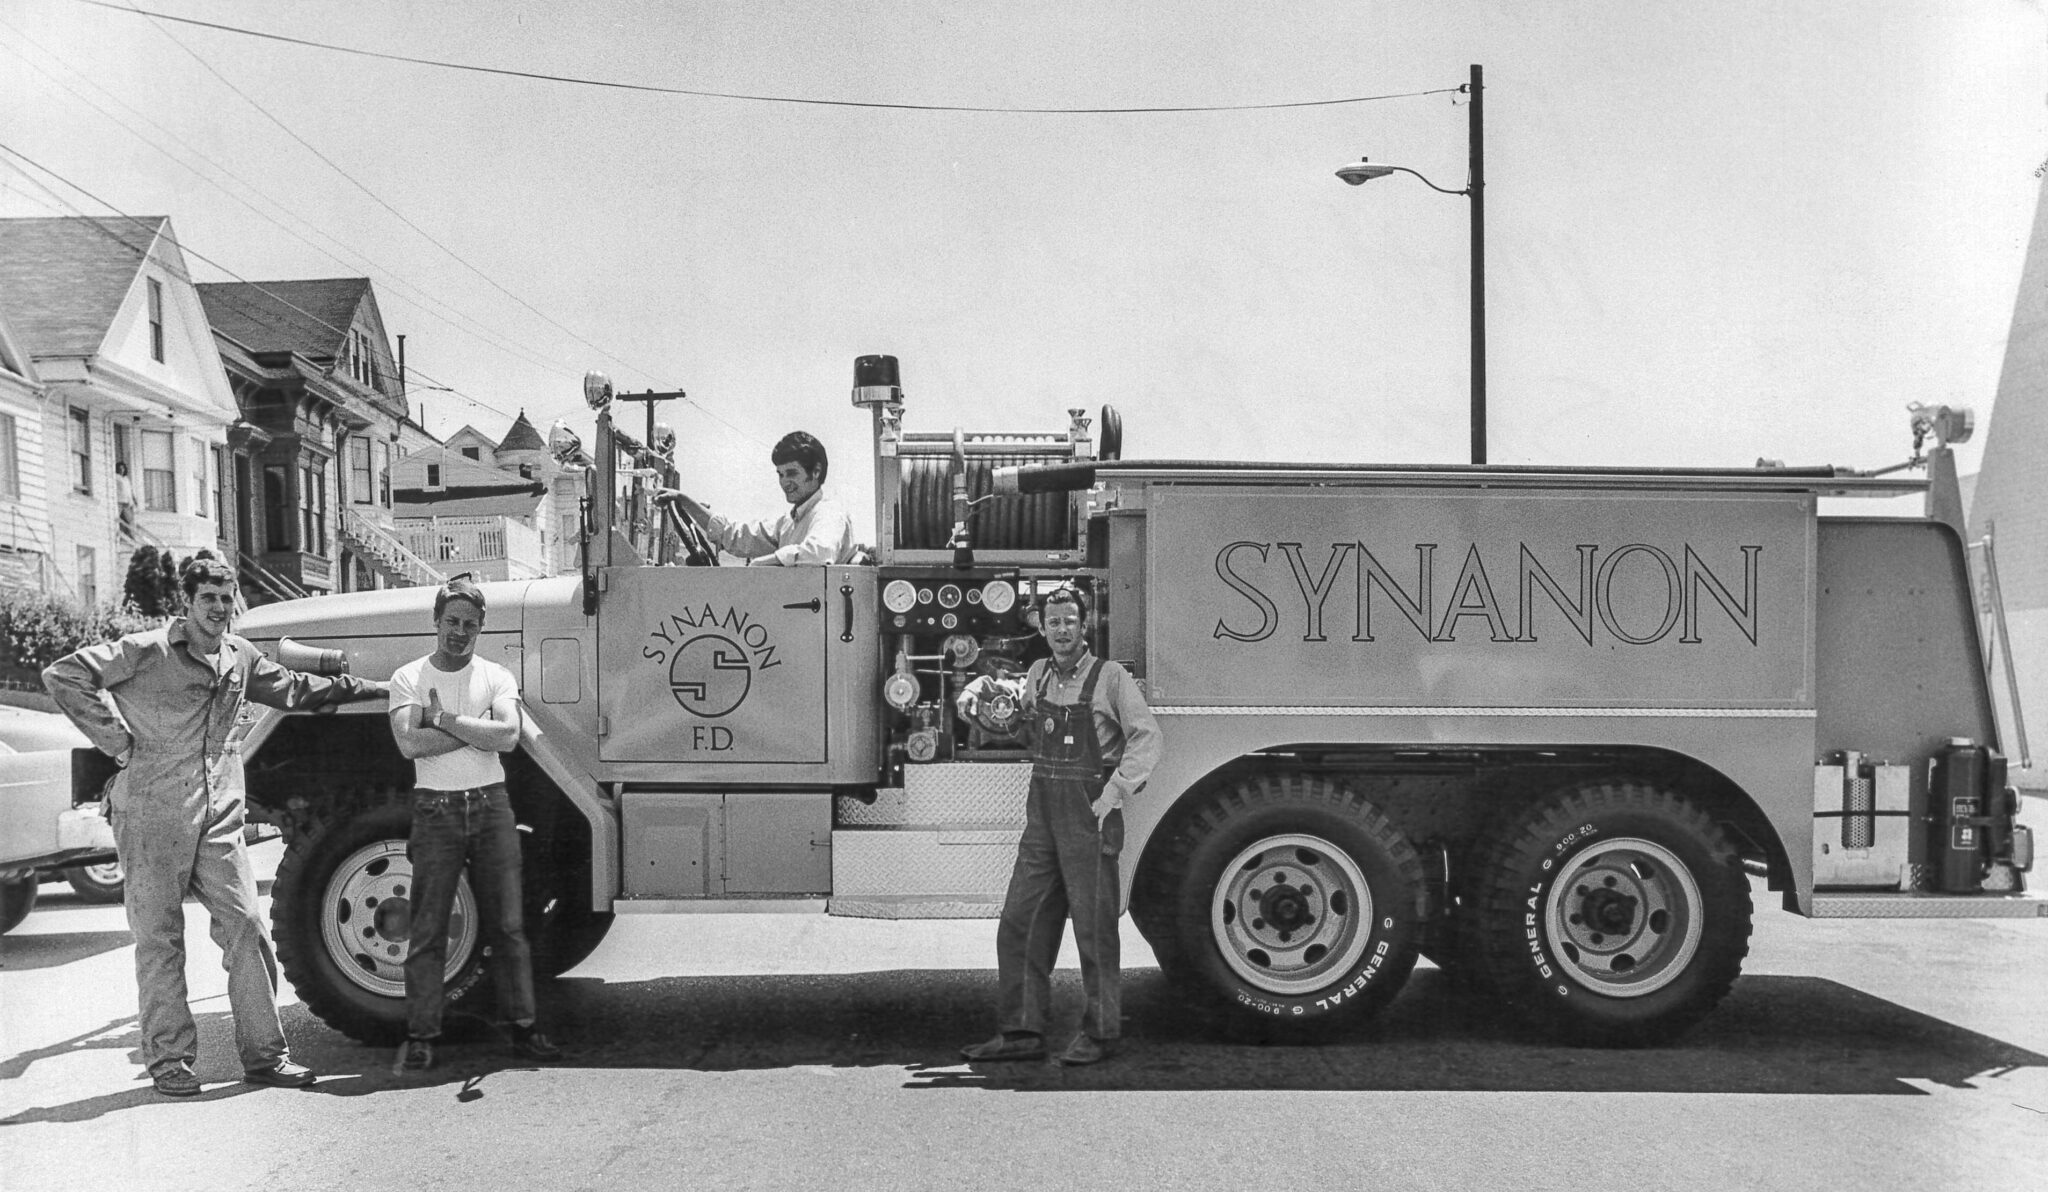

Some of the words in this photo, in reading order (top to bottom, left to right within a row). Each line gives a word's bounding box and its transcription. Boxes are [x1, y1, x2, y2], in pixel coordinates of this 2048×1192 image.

[1213, 540, 1763, 647] SYNANON
[642, 602, 782, 671] SYNANON
[692, 725, 734, 751] F.D.
[1383, 917, 1394, 930] G
[1525, 882, 1553, 979] GENERAL
[1292, 1004, 1304, 1015] G
[1315, 940, 1390, 1011] GENERAL
